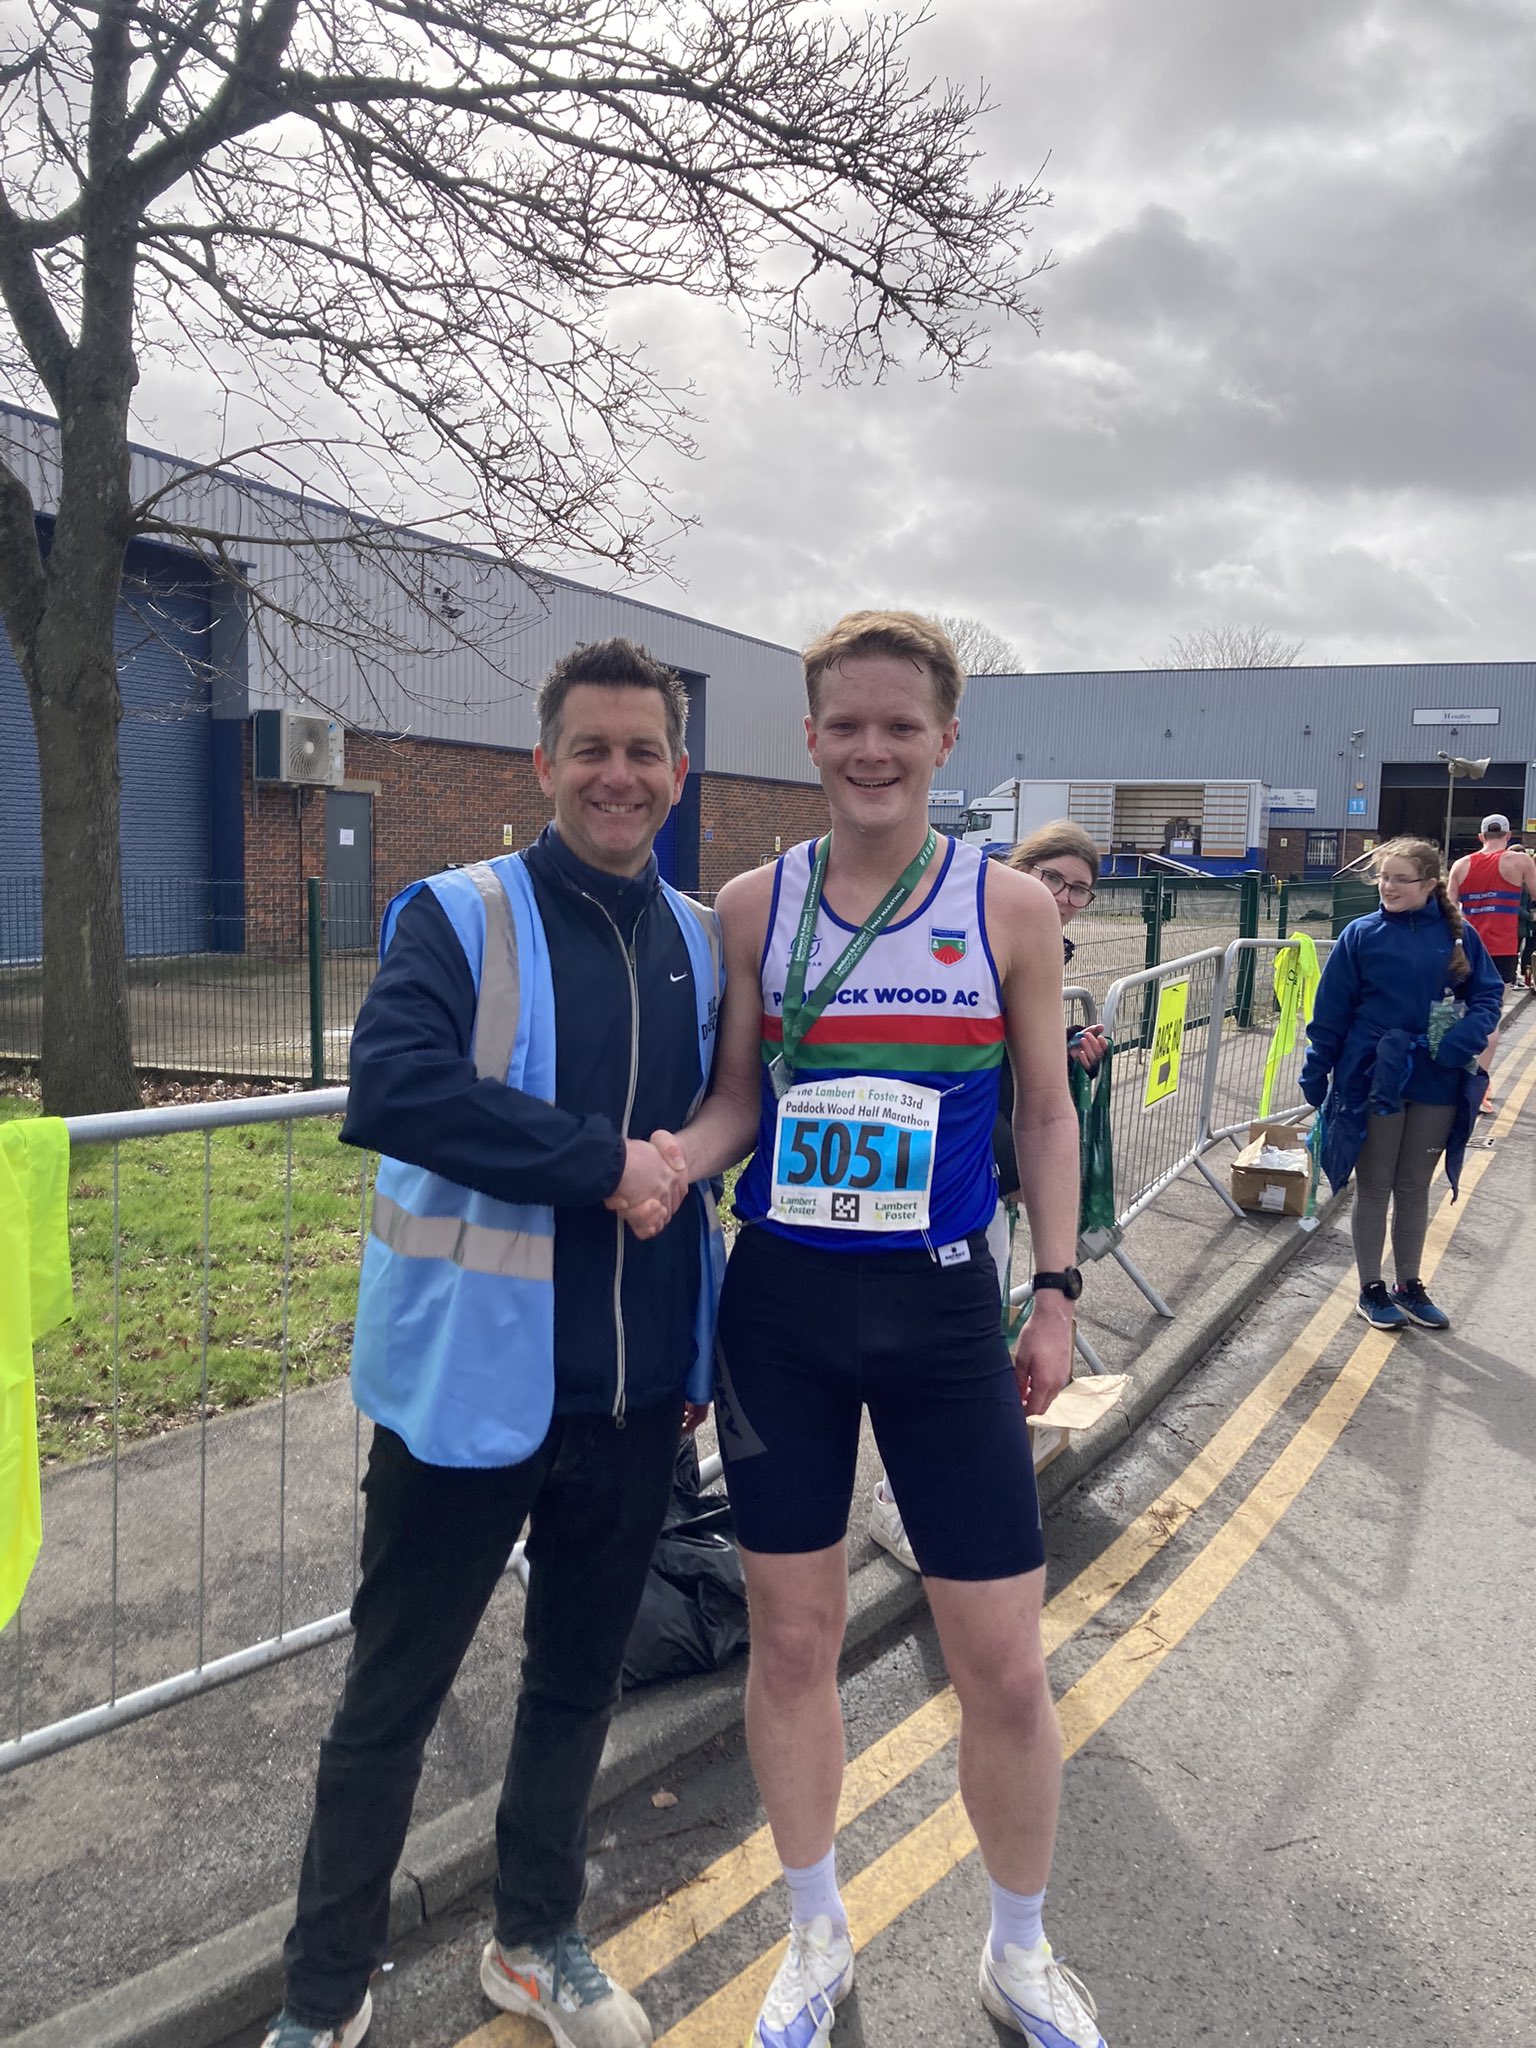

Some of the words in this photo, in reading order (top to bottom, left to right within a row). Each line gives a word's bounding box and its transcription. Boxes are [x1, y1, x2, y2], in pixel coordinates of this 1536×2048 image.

[1351, 800, 1364, 811] 11
[870, 916, 883, 930] HALF
[880, 887, 906, 917] MARATHON
[874, 988, 947, 1004] WOOD
[952, 990, 980, 1007] AC
[1154, 1022, 1173, 1061] RACE
[815, 1085, 855, 1099] Lambert
[868, 1089, 898, 1103] Foster
[900, 1094, 924, 1110] 33rd
[785, 1101, 825, 1114] Paddock
[827, 1103, 855, 1116] Wood
[858, 1105, 881, 1118] Half
[881, 1107, 930, 1128] Marathon
[787, 1121, 912, 1189] 5051
[780, 1195, 817, 1206] Lambert
[875, 1201, 918, 1211] Lambert
[788, 1206, 816, 1216] Foster
[885, 1211, 917, 1221] Foster
